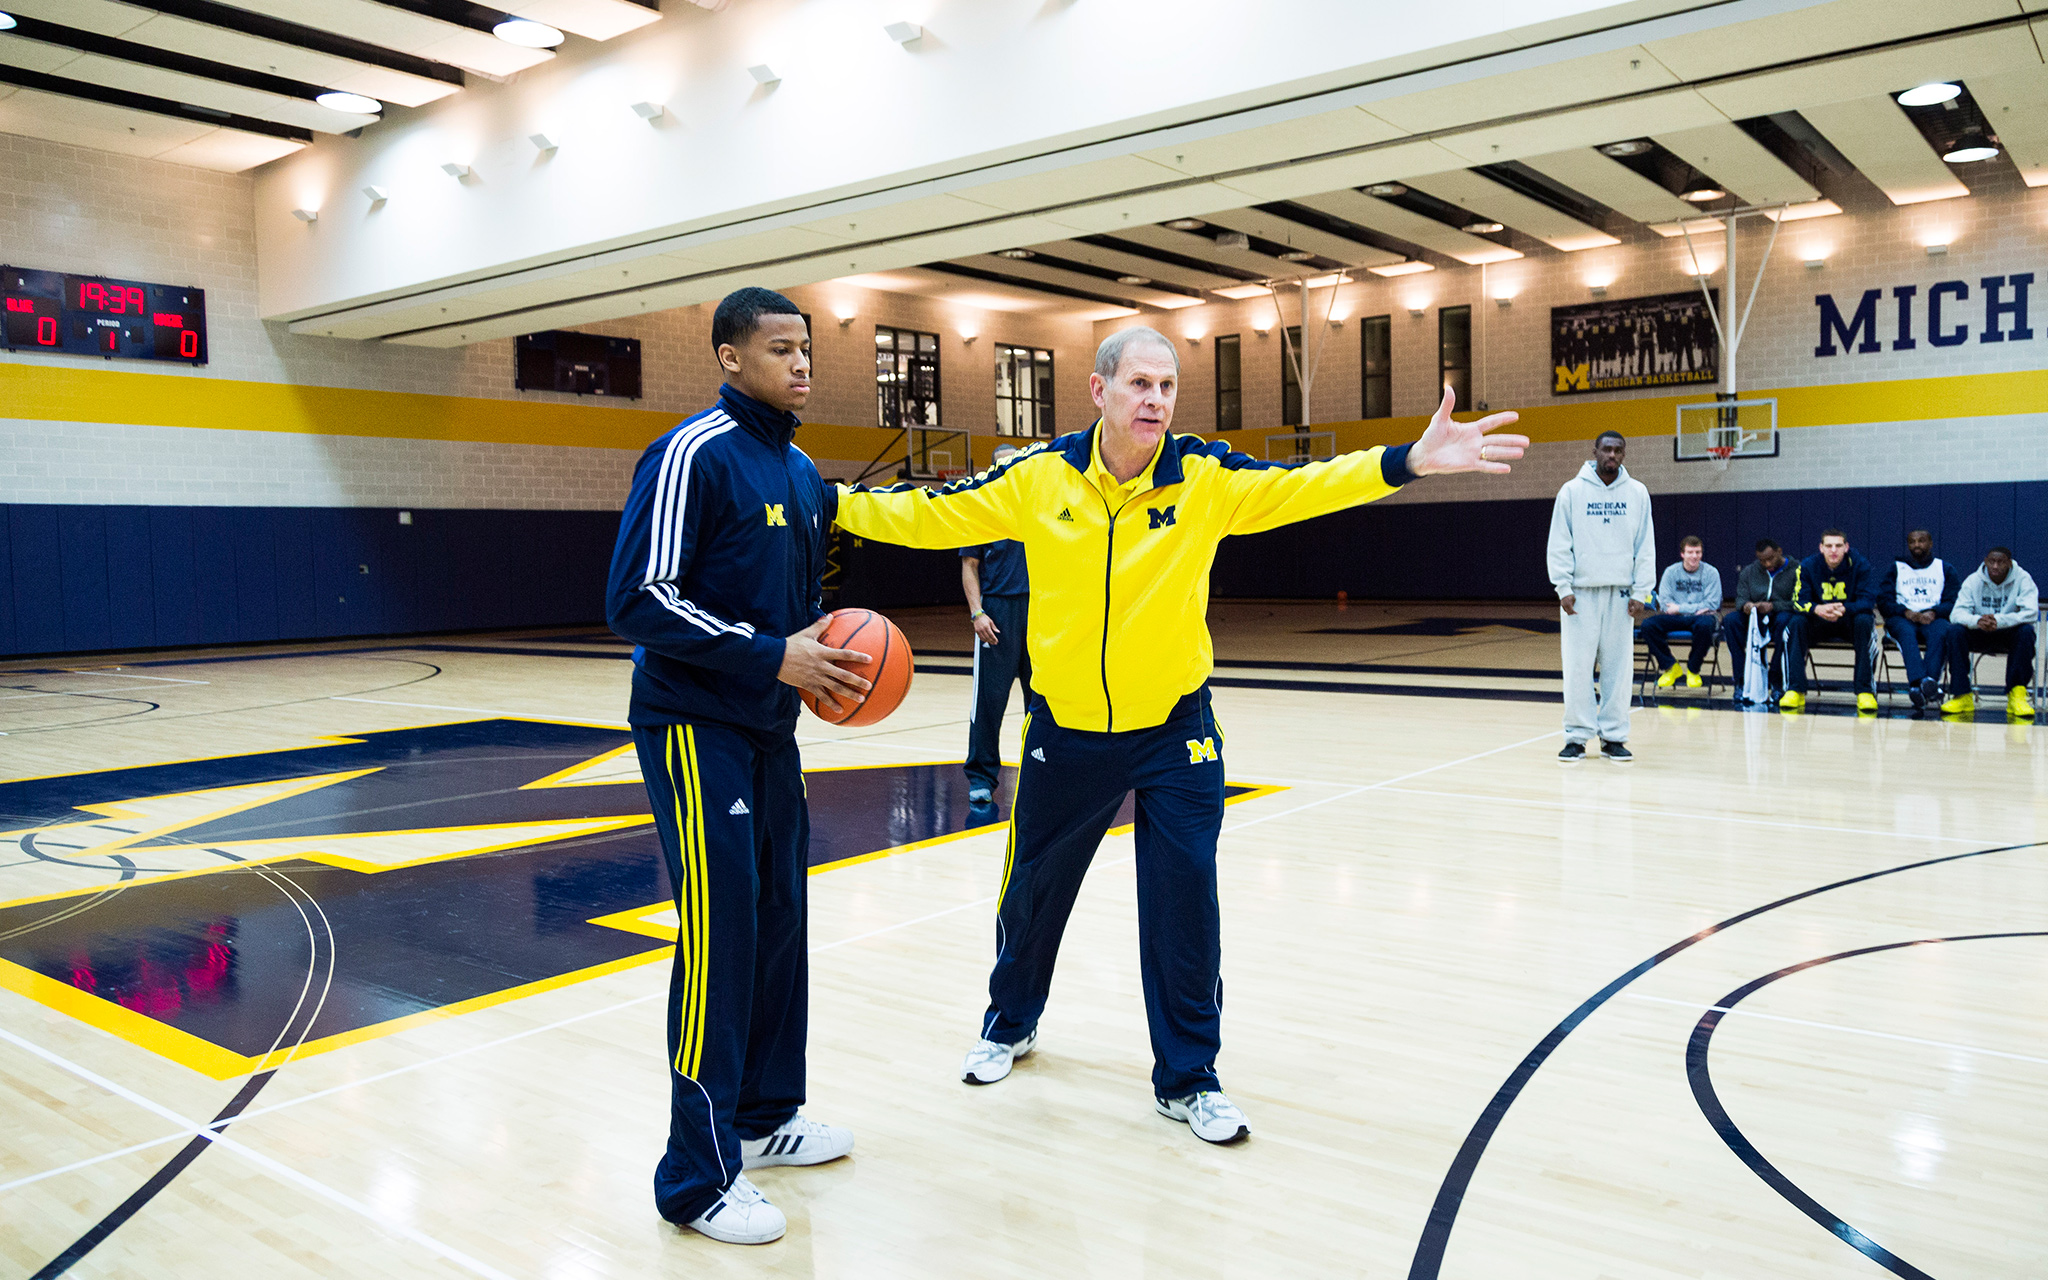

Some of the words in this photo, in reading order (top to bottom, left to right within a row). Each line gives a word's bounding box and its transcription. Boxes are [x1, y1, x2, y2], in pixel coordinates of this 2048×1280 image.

[80, 283, 144, 315] 19:39
[96, 318, 120, 328] PERIOD
[1815, 272, 2048, 358] MICH
[37, 316, 57, 346] 0
[109, 331, 116, 350] 1
[180, 330, 198, 358] 0
[1555, 363, 1591, 392] M
[1595, 375, 1643, 389] MICHIGAN
[1646, 370, 1714, 385] BASKETBALL
[764, 502, 788, 527] M
[1147, 504, 1177, 530] M
[1587, 502, 1627, 510] MICHIGAN
[1821, 581, 1848, 600] M
[1914, 587, 1928, 596] M
[1186, 736, 1219, 765] M
